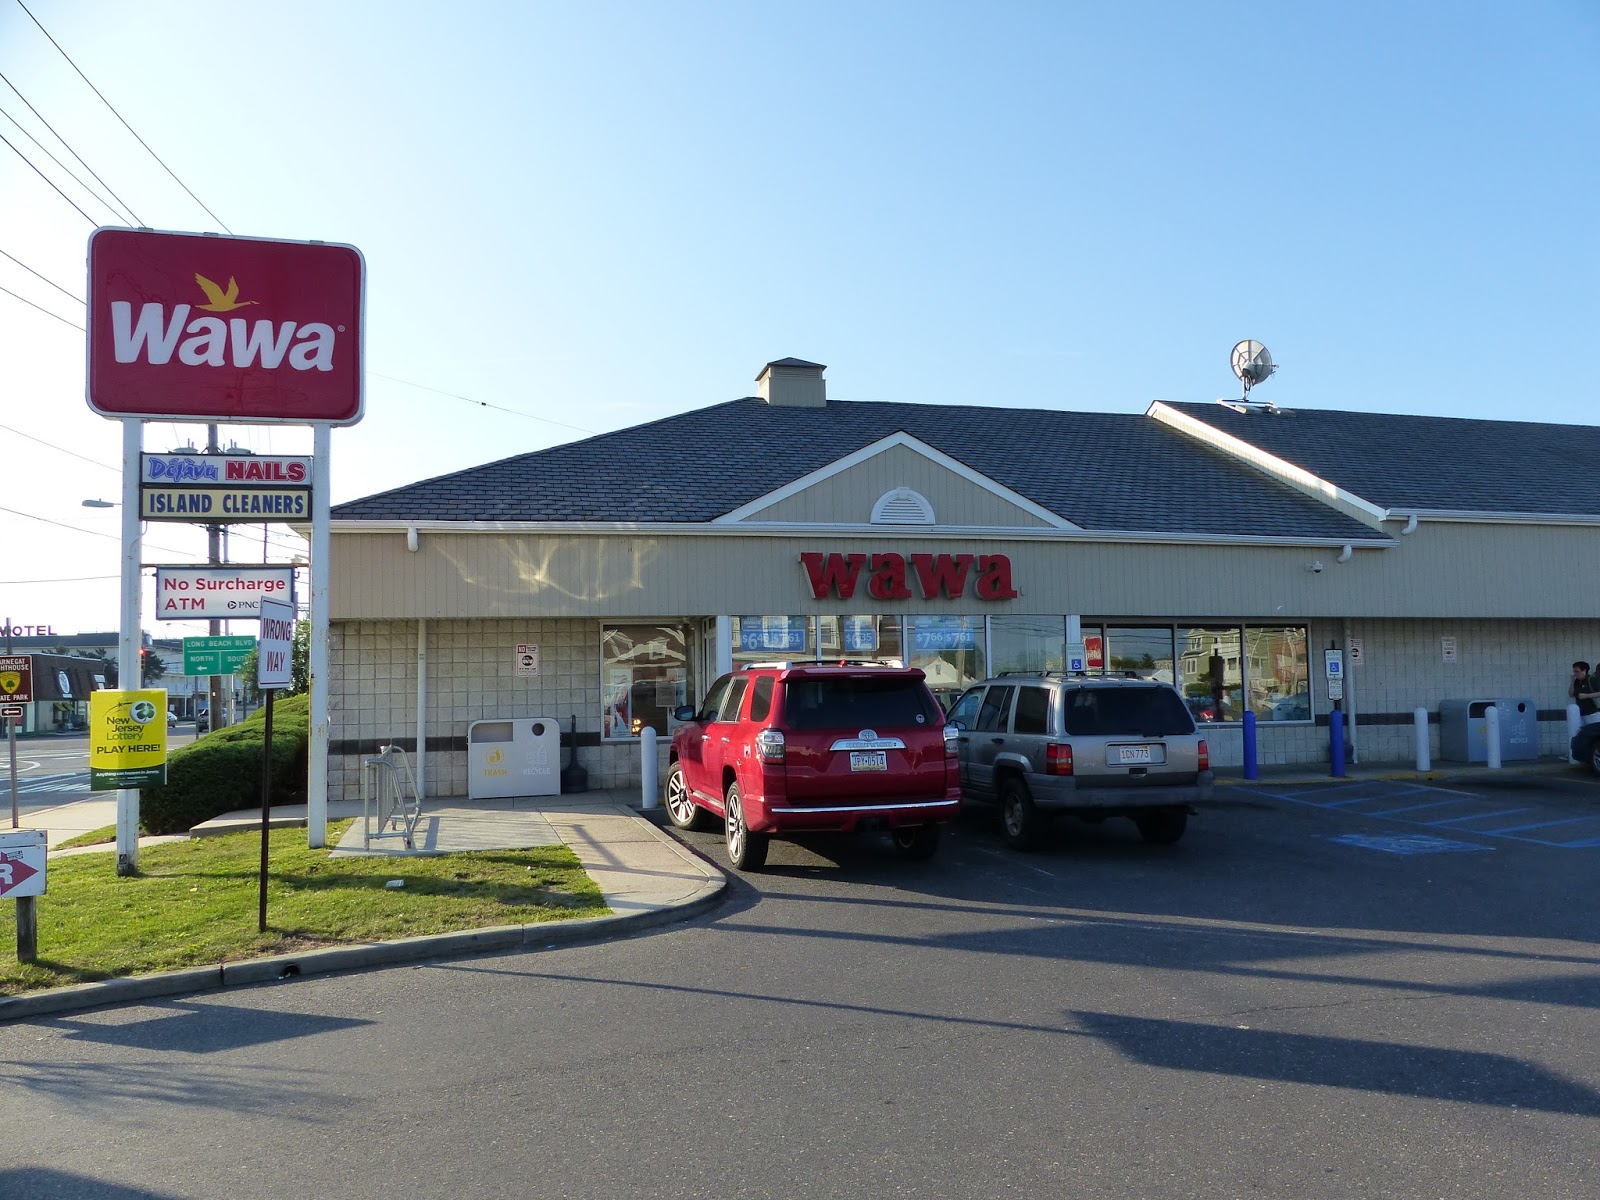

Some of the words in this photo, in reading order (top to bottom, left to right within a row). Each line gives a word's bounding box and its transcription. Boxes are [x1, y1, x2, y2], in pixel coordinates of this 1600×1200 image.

[111, 301, 335, 371] Wawa
[225, 460, 306, 482] NAILS
[150, 493, 212, 513] ISLAND
[222, 494, 303, 514] CLEANERS
[164, 578, 189, 590] No
[195, 577, 286, 592] Surcharge
[164, 598, 205, 610] ATM
[238, 601, 259, 609] PNC
[263, 617, 291, 641] WRONG
[266, 651, 286, 672] WAY
[13, 693, 29, 701] PARK
[106, 716, 130, 725] New
[112, 724, 145, 732] Jersey
[106, 732, 144, 741] Lottery
[96, 744, 125, 754] PLAY
[128, 744, 161, 753] HERE!
[523, 767, 551, 775] RECYCLE
